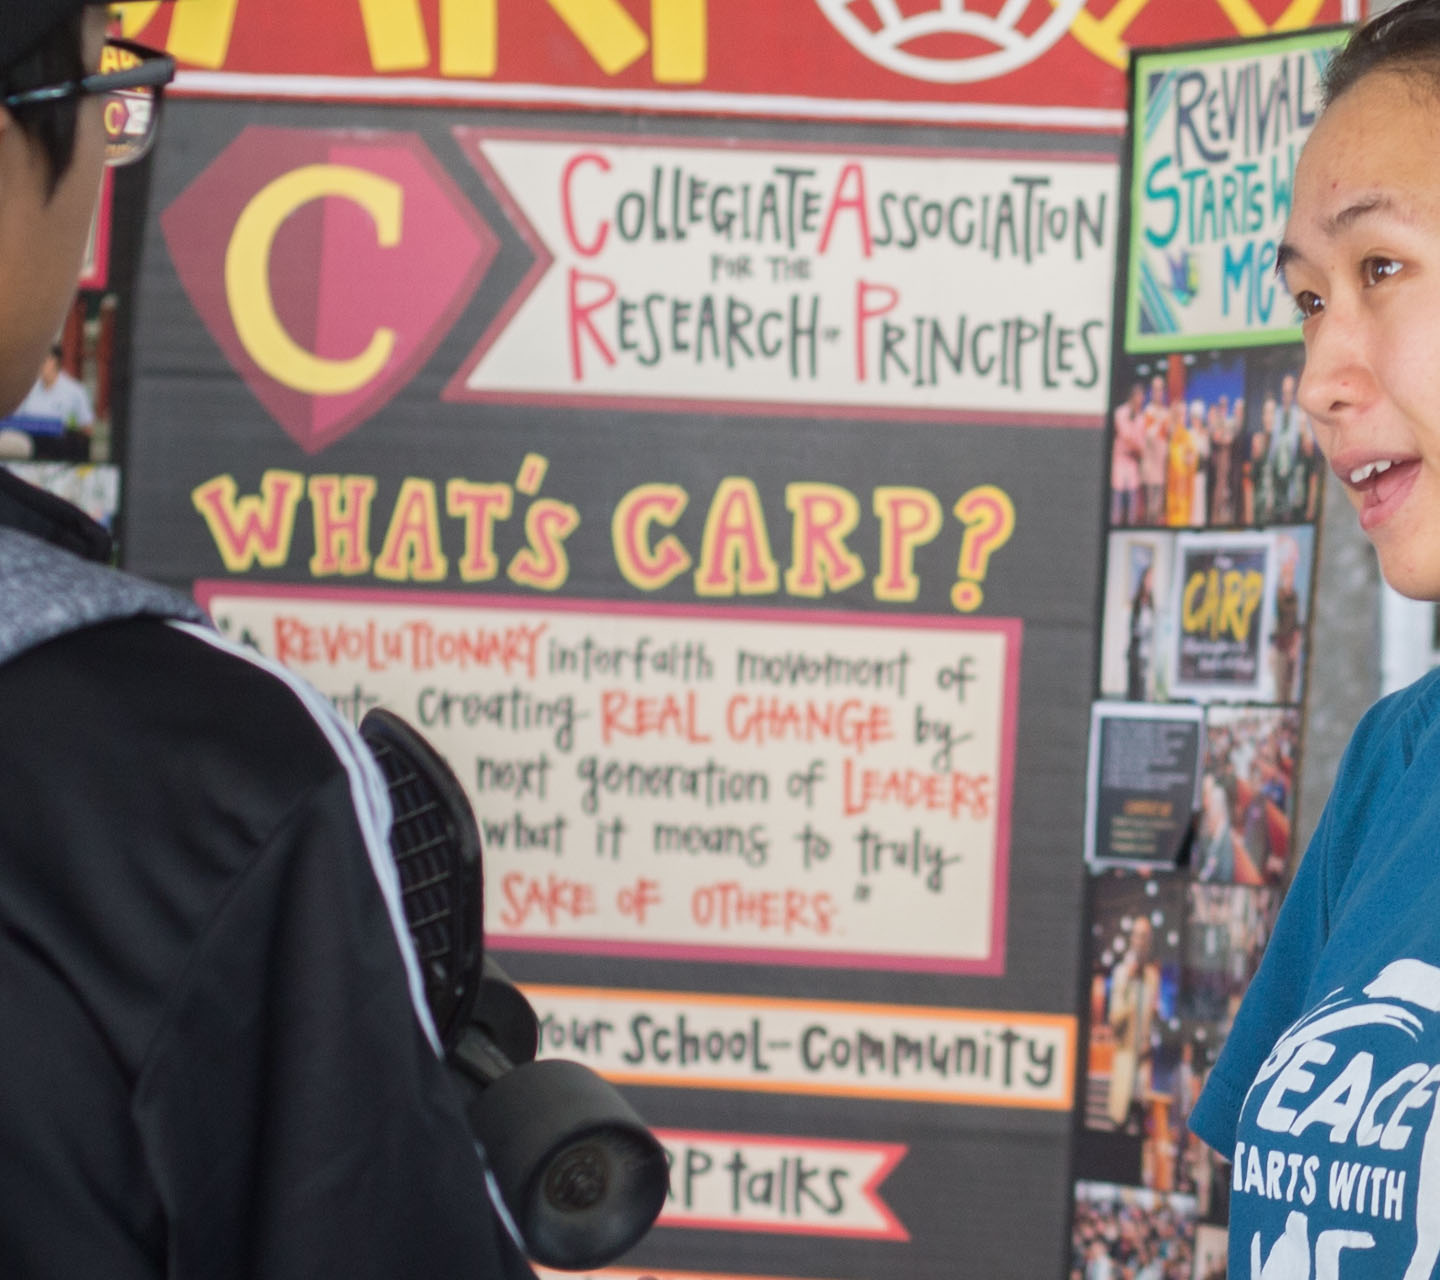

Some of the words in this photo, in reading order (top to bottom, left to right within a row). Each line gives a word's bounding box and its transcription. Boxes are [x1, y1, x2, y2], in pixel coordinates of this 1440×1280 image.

[1144, 155, 1265, 249] STARTS
[710, 254, 753, 283] FOR
[764, 255, 812, 282] THE
[567, 266, 820, 382] RESEARCH
[855, 278, 1105, 391] PRINCIPLES
[192, 454, 579, 589] WHAT'S
[611, 476, 1015, 613] CARP?
[1182, 569, 1265, 642] CARP
[273, 615, 548, 679] REVOLUTIONARY
[548, 635, 714, 683] interfaith
[737, 647, 911, 698] movement
[936, 655, 976, 703] of
[600, 688, 713, 745] REAL
[725, 693, 894, 754] CHANGE
[914, 703, 973, 774] by
[475, 752, 552, 800] next
[576, 754, 769, 814] generation
[786, 760, 825, 809] of
[843, 757, 992, 819] LEADERS
[595, 816, 627, 861] it
[653, 821, 771, 868] means
[795, 822, 832, 870] to
[854, 825, 962, 893] truly
[500, 868, 596, 928] SAKE
[724, 1148, 851, 1216] talks
[1329, 1160, 1406, 1221] WITH
